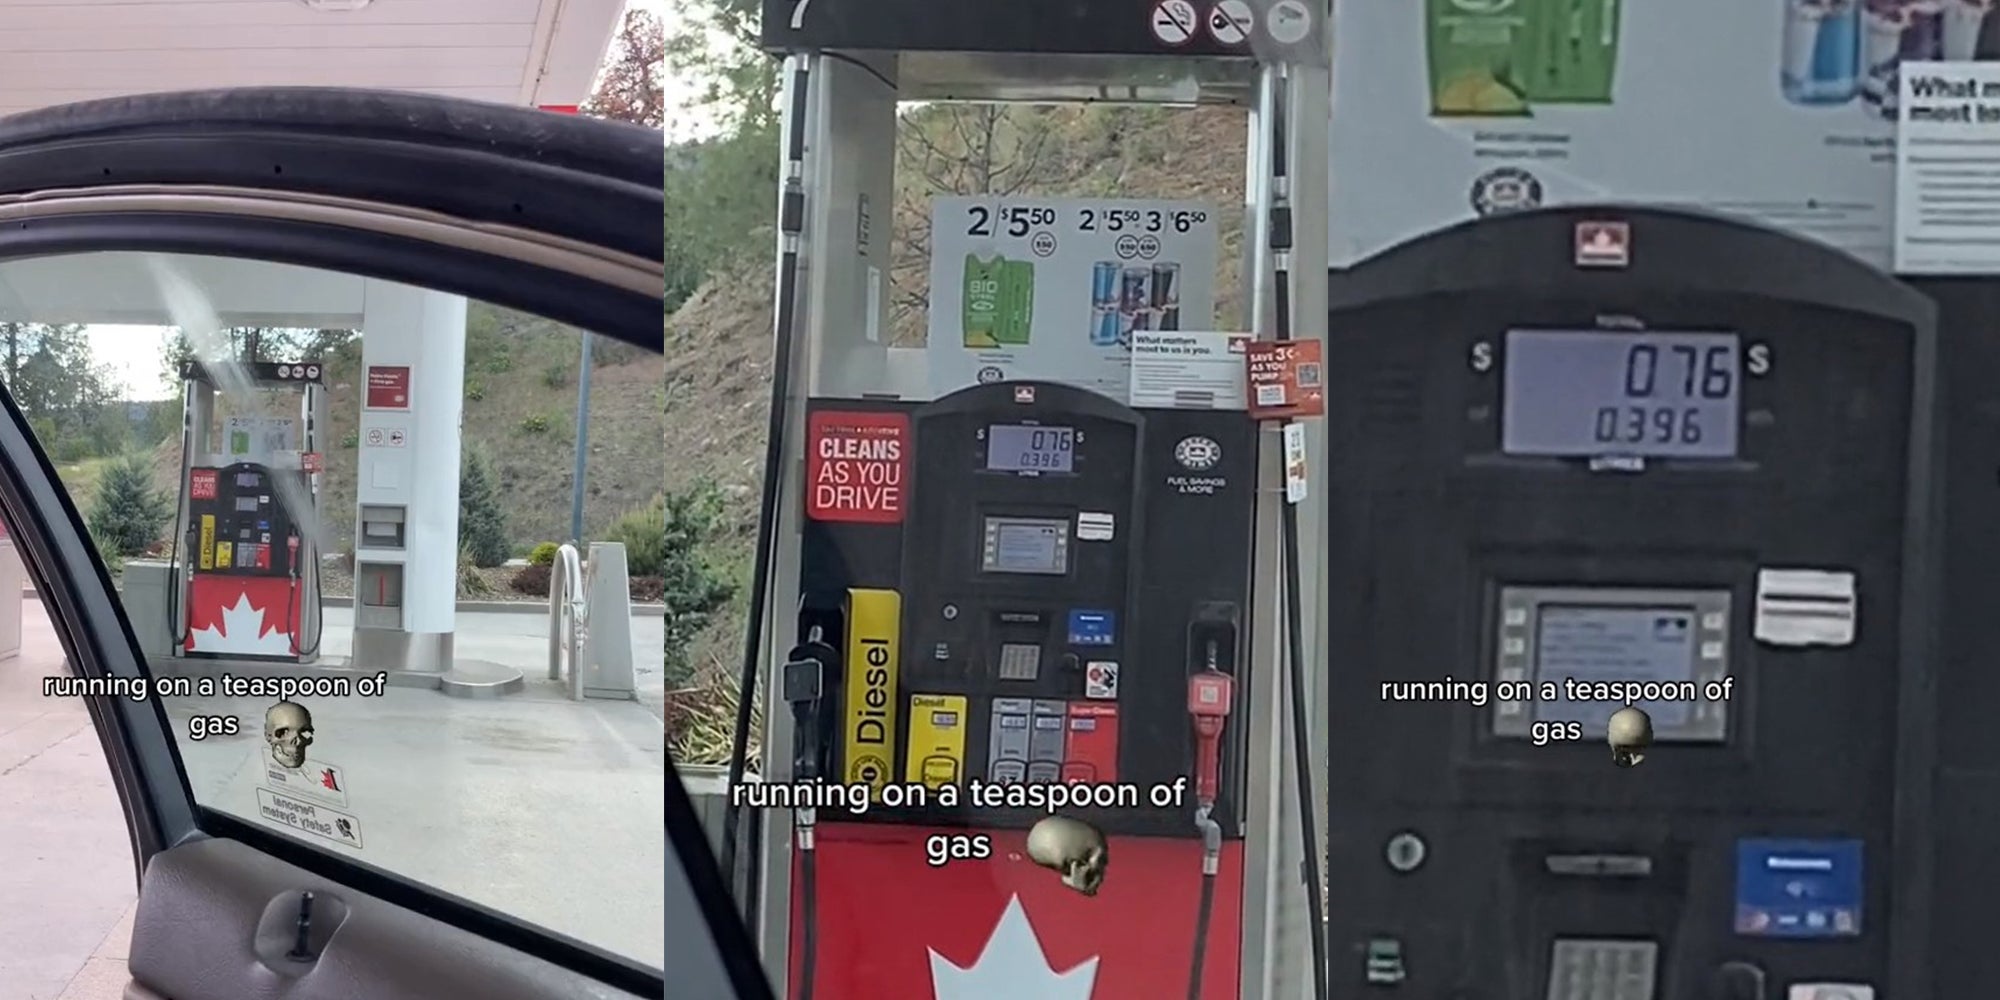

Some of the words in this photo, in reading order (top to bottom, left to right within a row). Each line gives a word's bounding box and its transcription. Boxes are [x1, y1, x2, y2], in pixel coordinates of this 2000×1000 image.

[1909, 77, 1977, 98] What
[970, 280, 998, 293] BIO
[1251, 363, 1264, 372] AS
[819, 438, 901, 460] CLEANS
[818, 461, 850, 484] AS
[856, 462, 900, 485] YOU
[816, 485, 898, 510] DRIVE
[857, 639, 889, 744] Diesel
